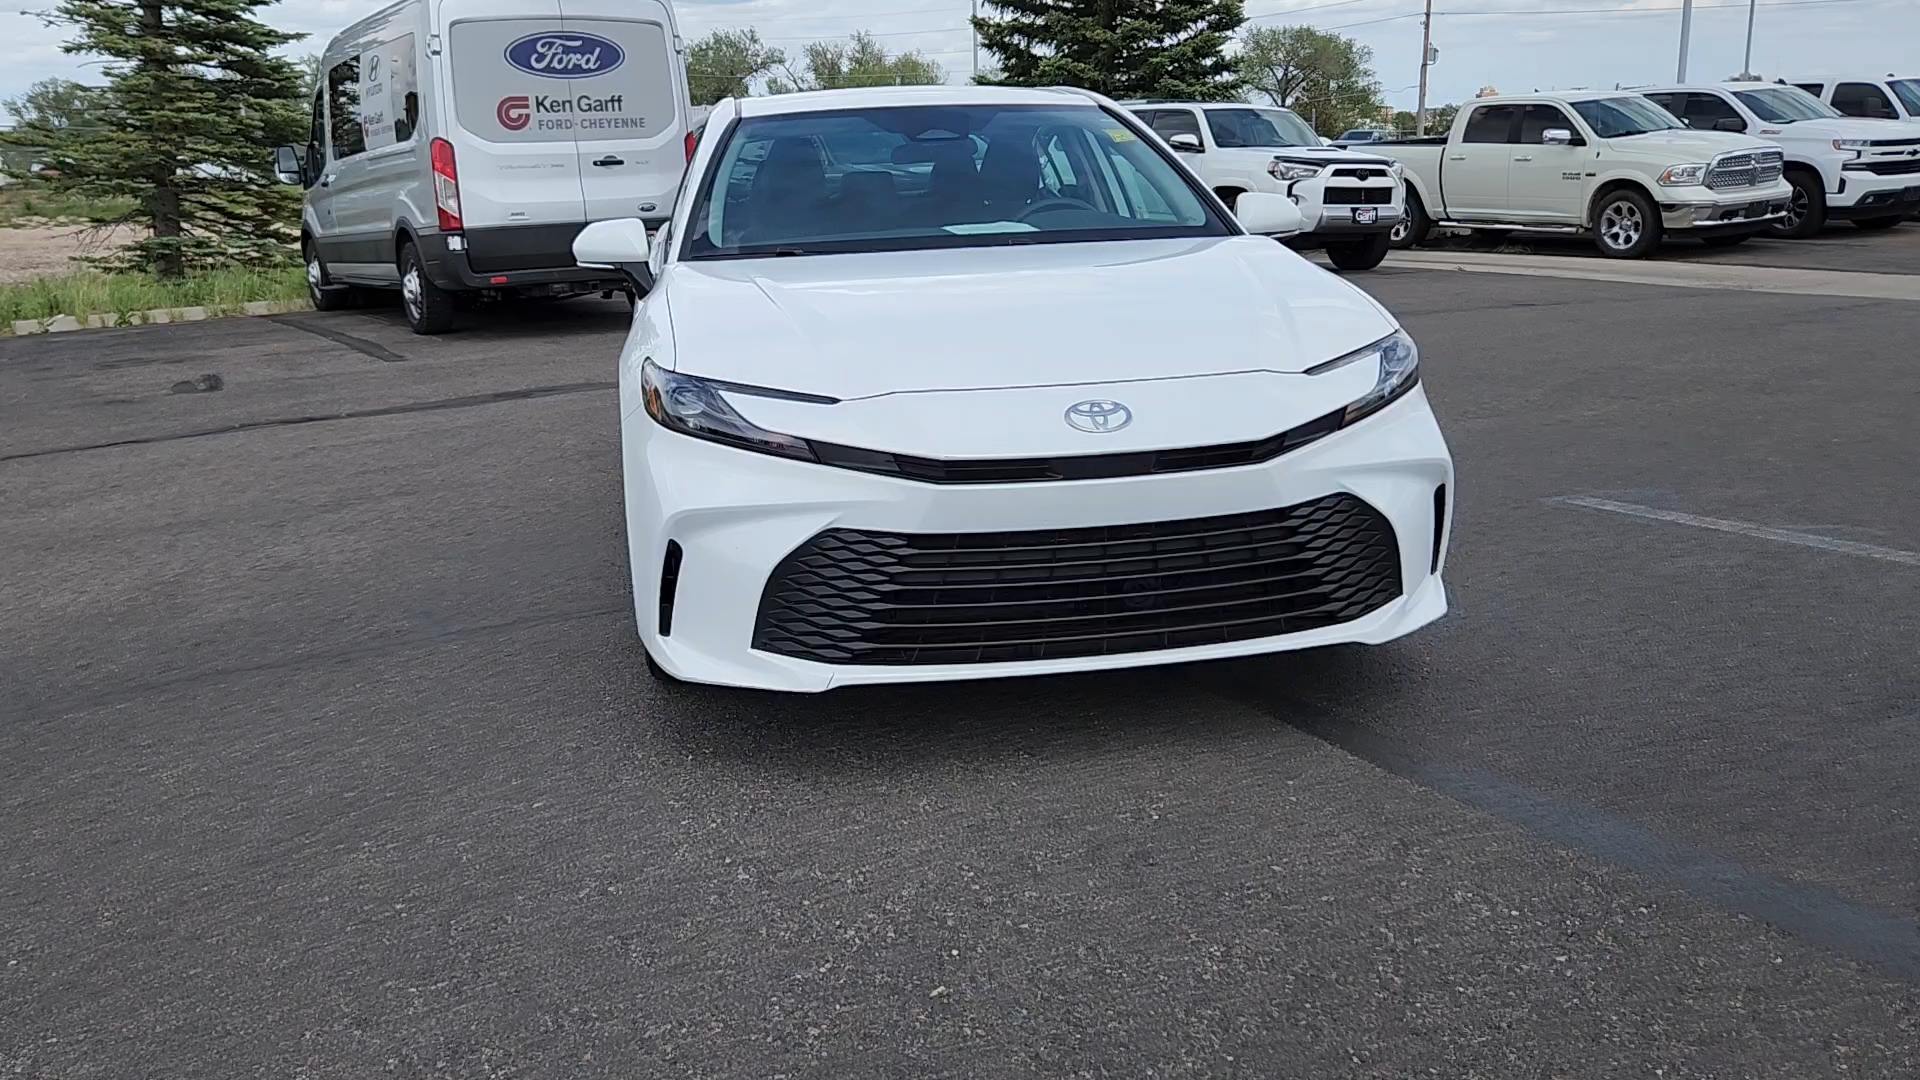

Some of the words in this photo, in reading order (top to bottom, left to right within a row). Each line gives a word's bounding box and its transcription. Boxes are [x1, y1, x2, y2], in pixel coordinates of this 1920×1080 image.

[530, 37, 602, 70] Ford
[535, 95, 573, 114] Ken
[576, 94, 624, 113] Garff
[538, 119, 574, 131] FORD
[580, 117, 646, 130] CHEYENNE
[1355, 209, 1377, 221] Garff
